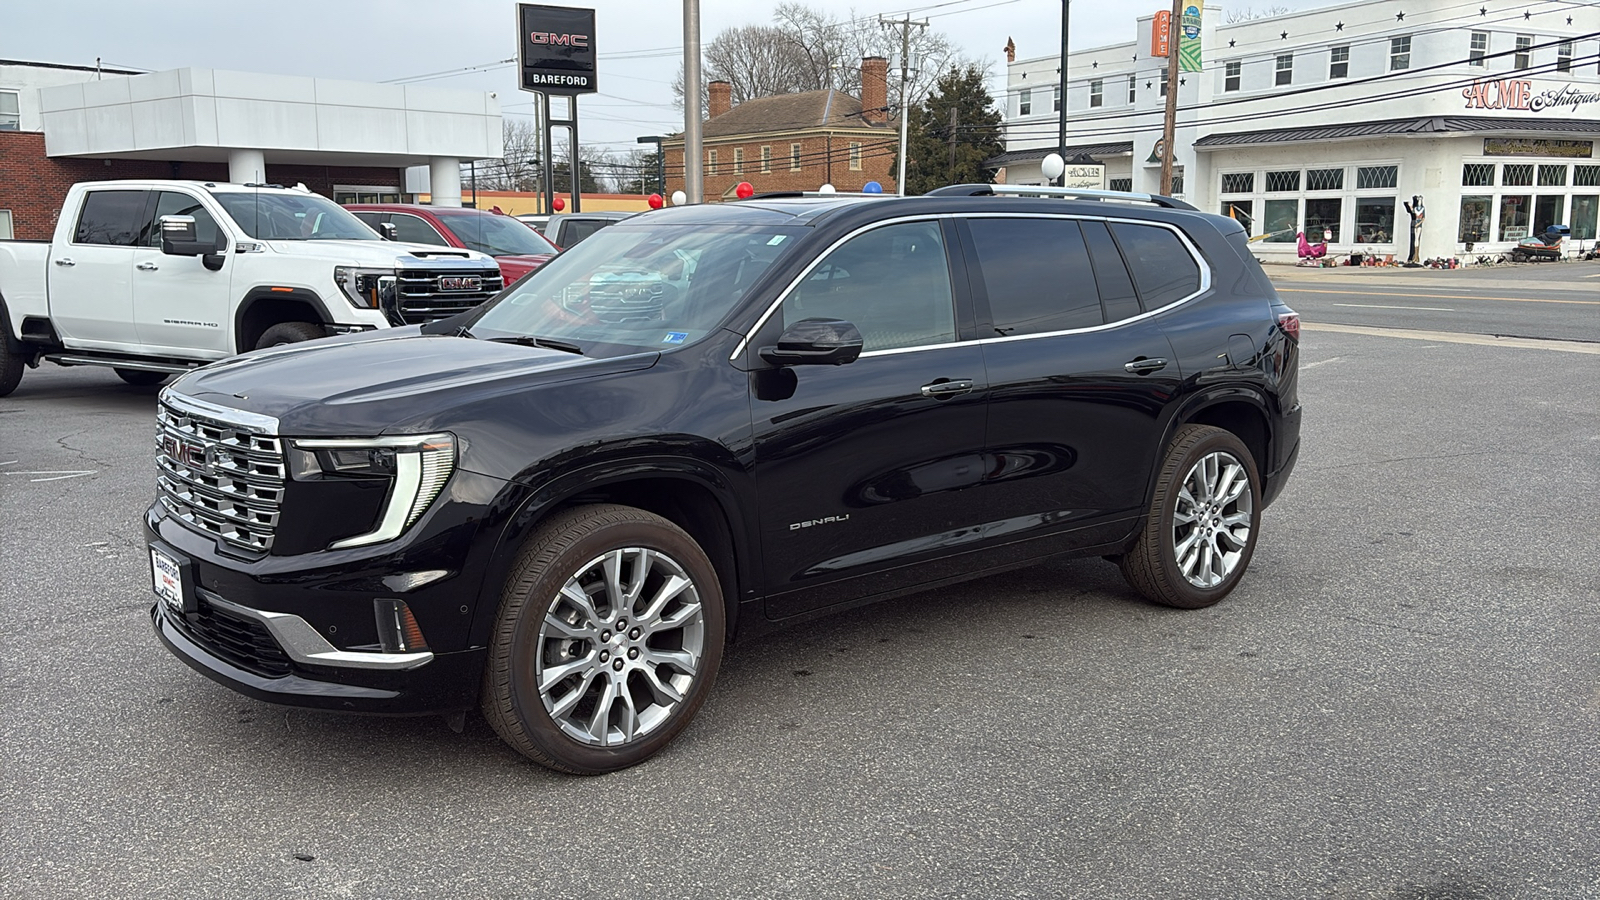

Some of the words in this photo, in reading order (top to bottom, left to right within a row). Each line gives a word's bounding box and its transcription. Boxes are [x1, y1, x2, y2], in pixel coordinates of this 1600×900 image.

[530, 31, 588, 47] GMC
[1160, 13, 1168, 54] ACME
[533, 73, 588, 86] BAREFORD
[1462, 79, 1532, 110] ACME
[1067, 167, 1100, 178] ACME
[443, 277, 481, 289] GMC
[163, 435, 205, 468] GMC
[789, 513, 850, 531] DENALI
[155, 556, 180, 581] BAREFORD
[162, 574, 176, 589] GMC
